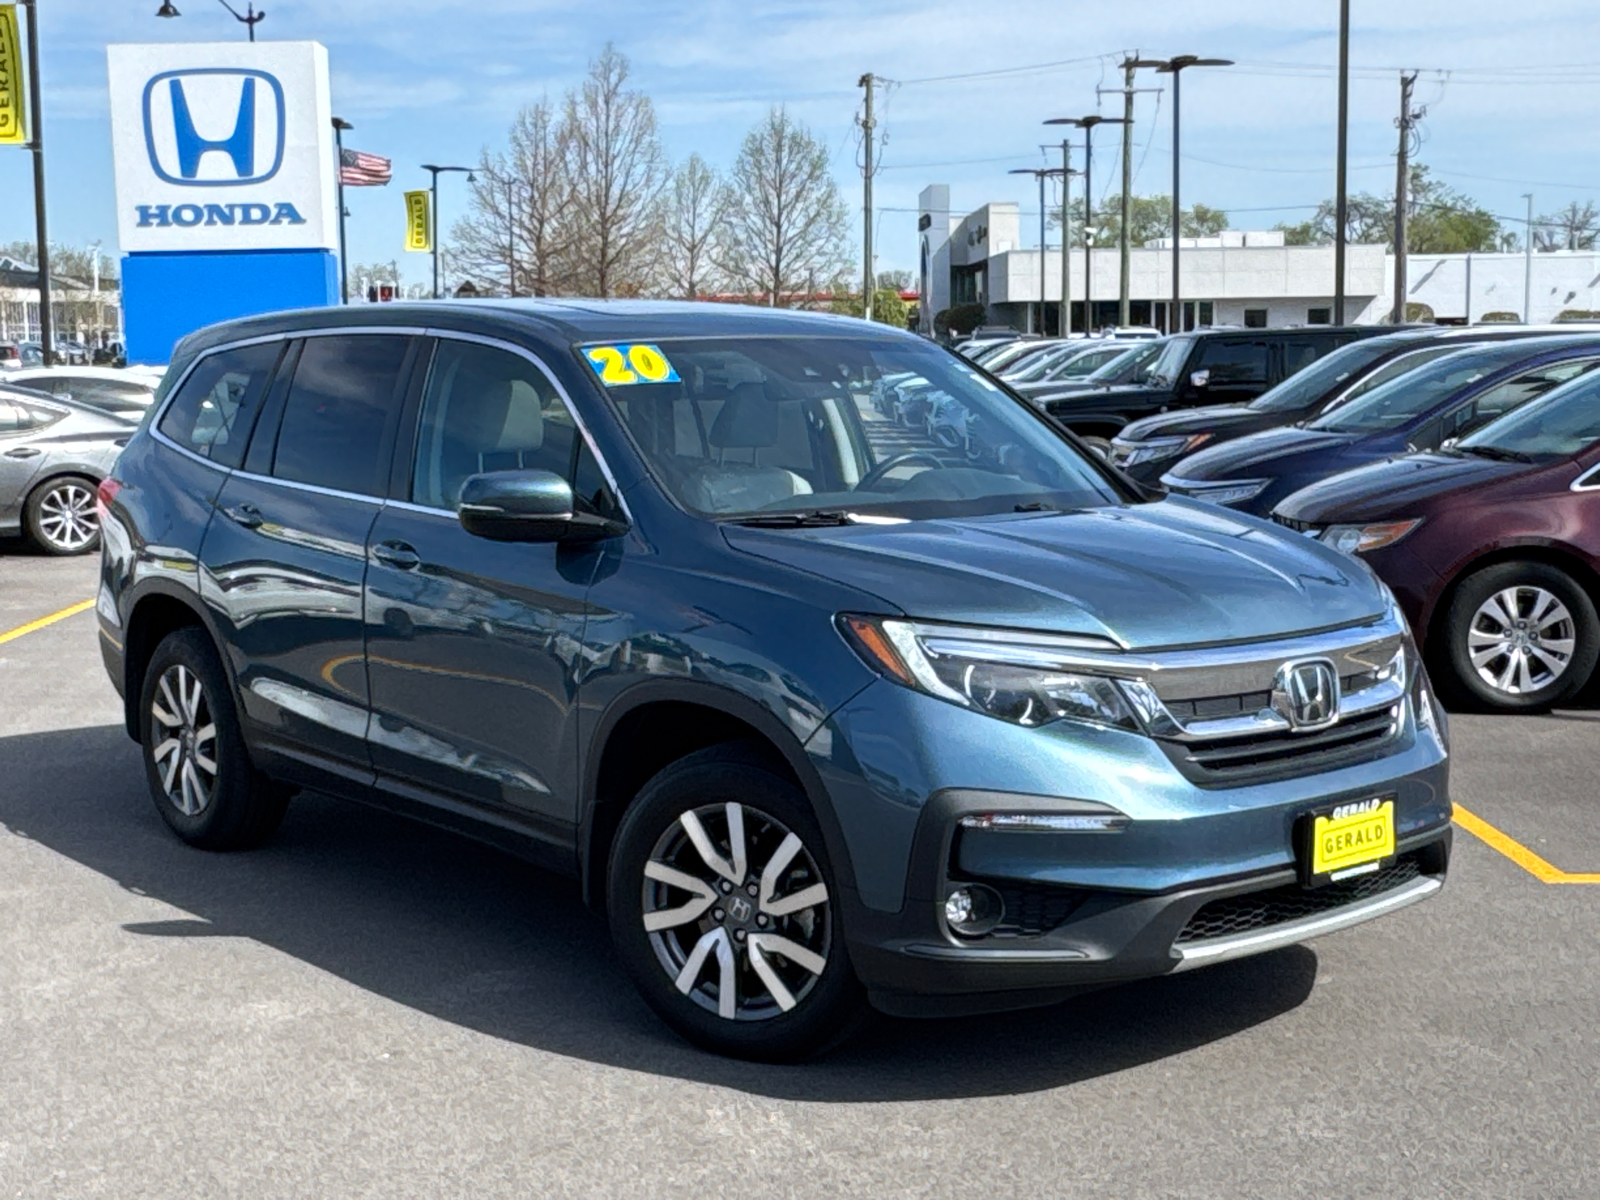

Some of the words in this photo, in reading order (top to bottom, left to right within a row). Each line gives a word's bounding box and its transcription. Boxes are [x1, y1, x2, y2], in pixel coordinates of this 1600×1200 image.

[0, 28, 10, 128] GERA
[135, 202, 307, 228] HONDA
[589, 345, 669, 384] 20
[1325, 824, 1384, 854] GERALD
